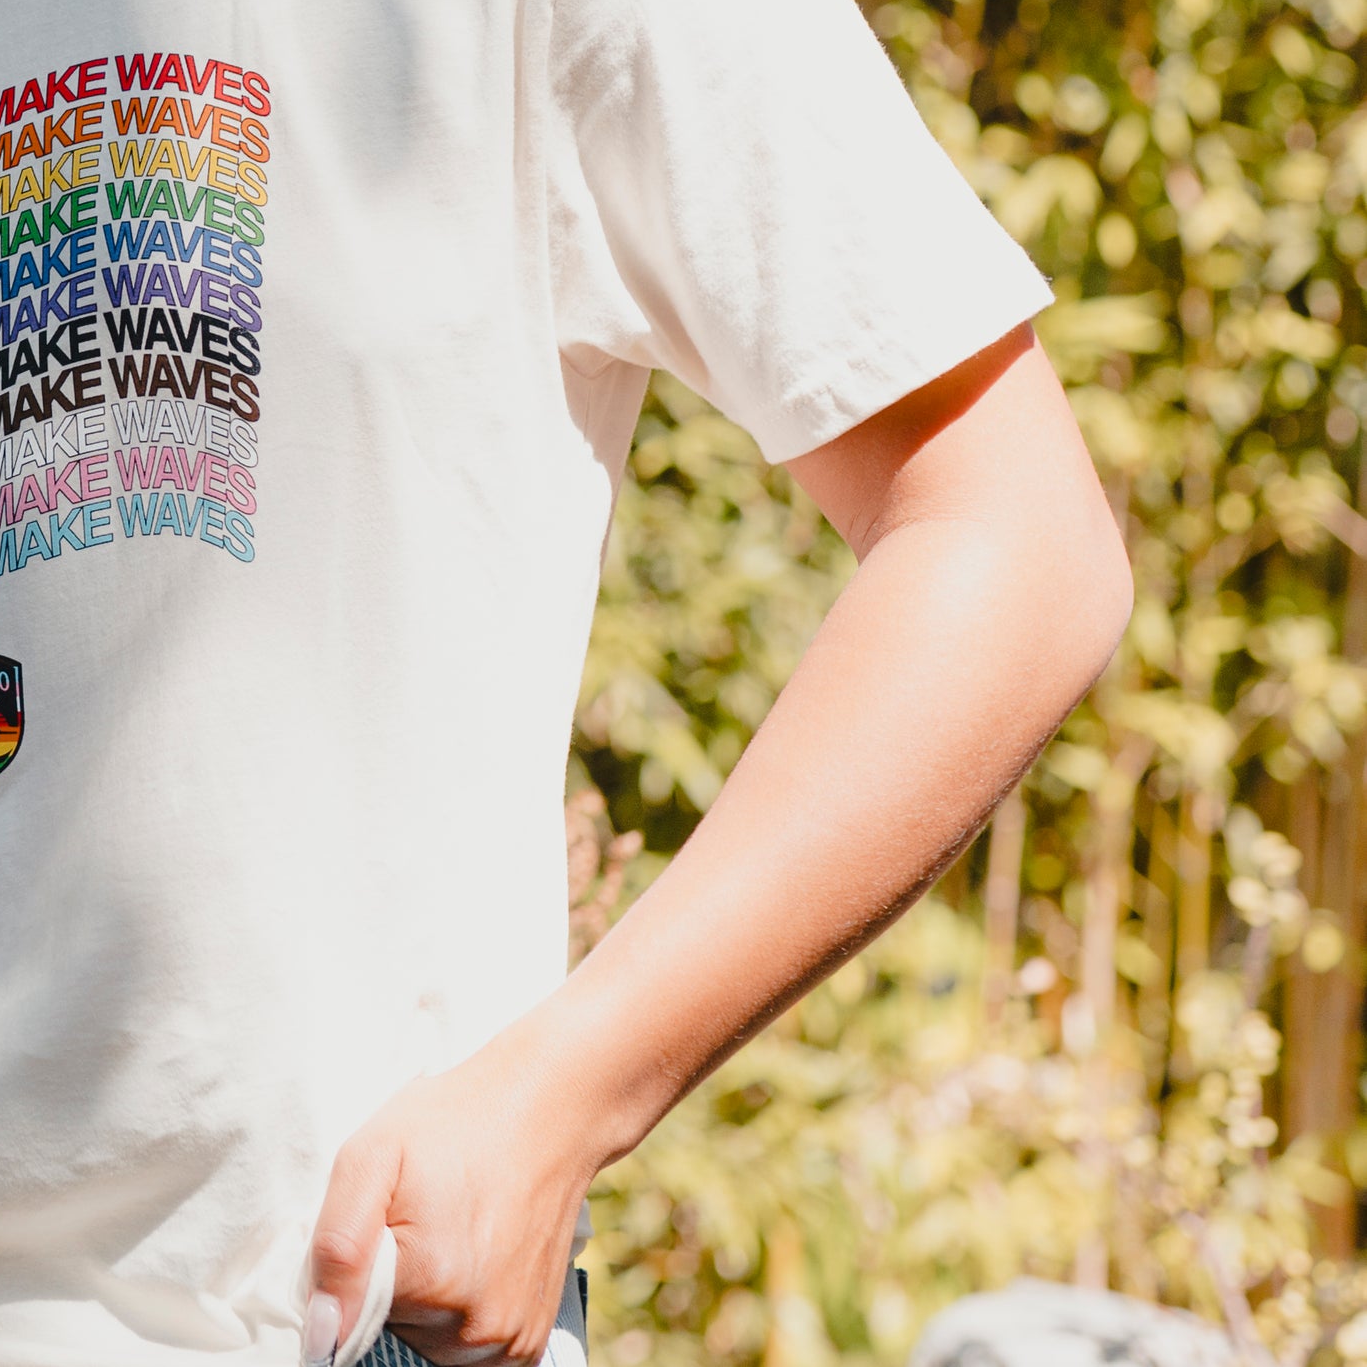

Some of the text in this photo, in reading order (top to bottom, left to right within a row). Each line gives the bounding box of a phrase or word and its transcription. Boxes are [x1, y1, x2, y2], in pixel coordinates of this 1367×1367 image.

[115, 53, 271, 117] WAVES
[111, 96, 271, 163] WAVES
[108, 139, 268, 207] WAVES
[105, 179, 265, 247] WAVES
[103, 220, 263, 288] WAVES
[102, 263, 263, 333] WAVES
[103, 308, 262, 376] WAVES
[108, 354, 261, 423] WAVES
[111, 399, 259, 469] WAVES
[115, 446, 258, 516] WAVES
[117, 492, 256, 563] WAVES
